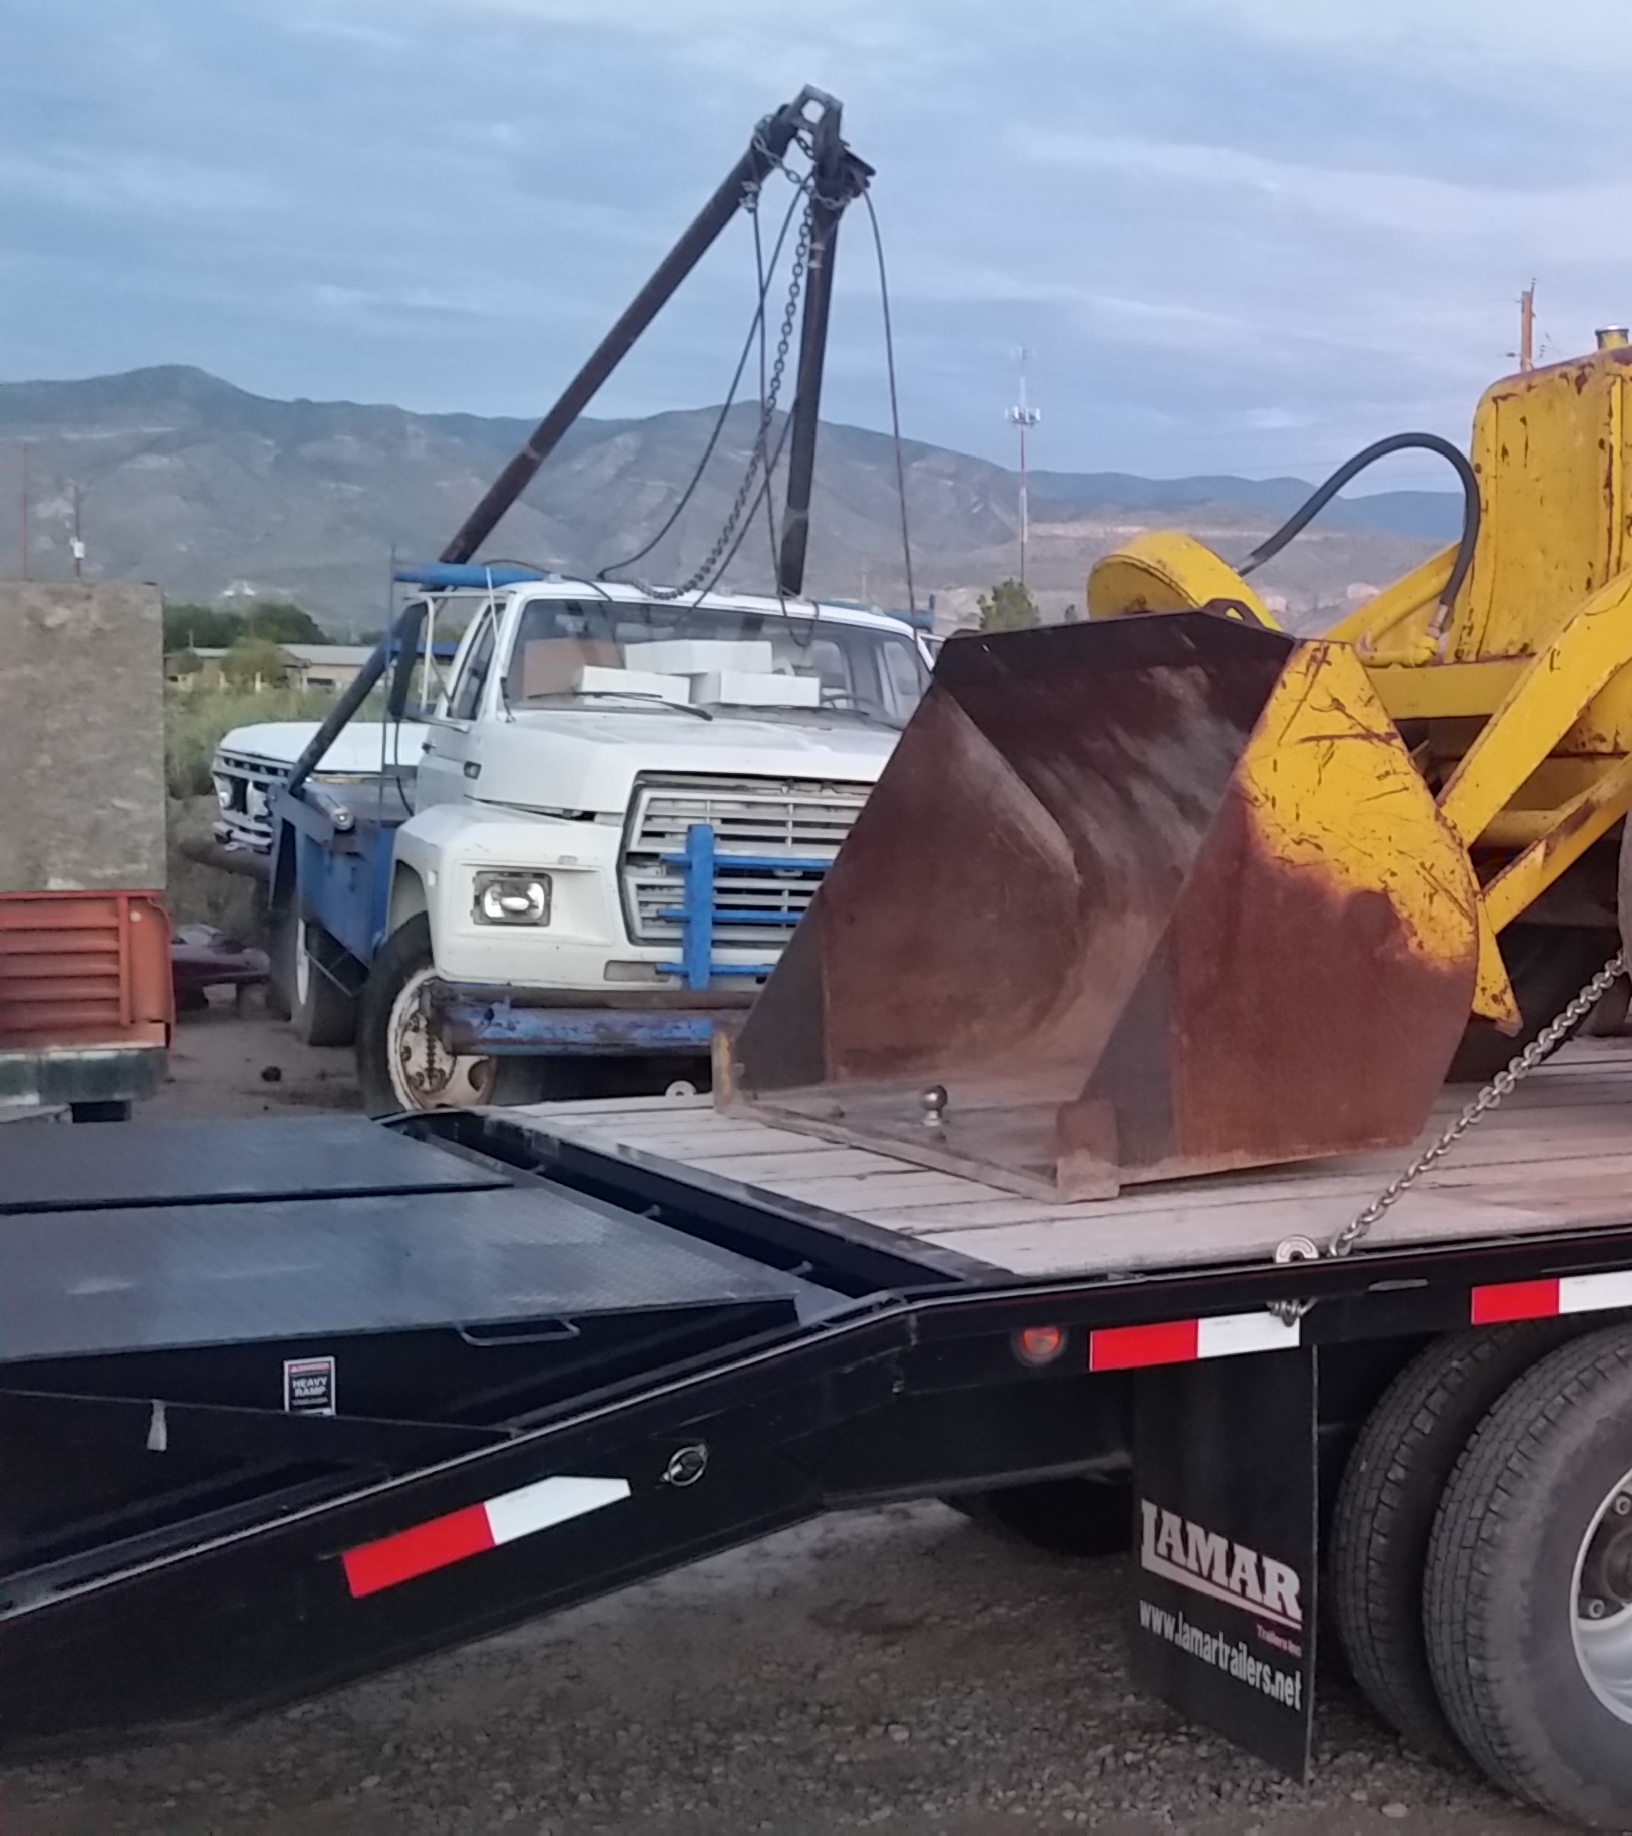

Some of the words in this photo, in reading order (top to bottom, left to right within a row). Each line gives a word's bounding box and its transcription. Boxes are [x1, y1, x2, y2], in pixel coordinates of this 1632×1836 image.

[292, 1376, 328, 1389] HEAVY
[1141, 1498, 1303, 1631] LAMAR
[1139, 1599, 1302, 1711] www.lamartrailers.net
